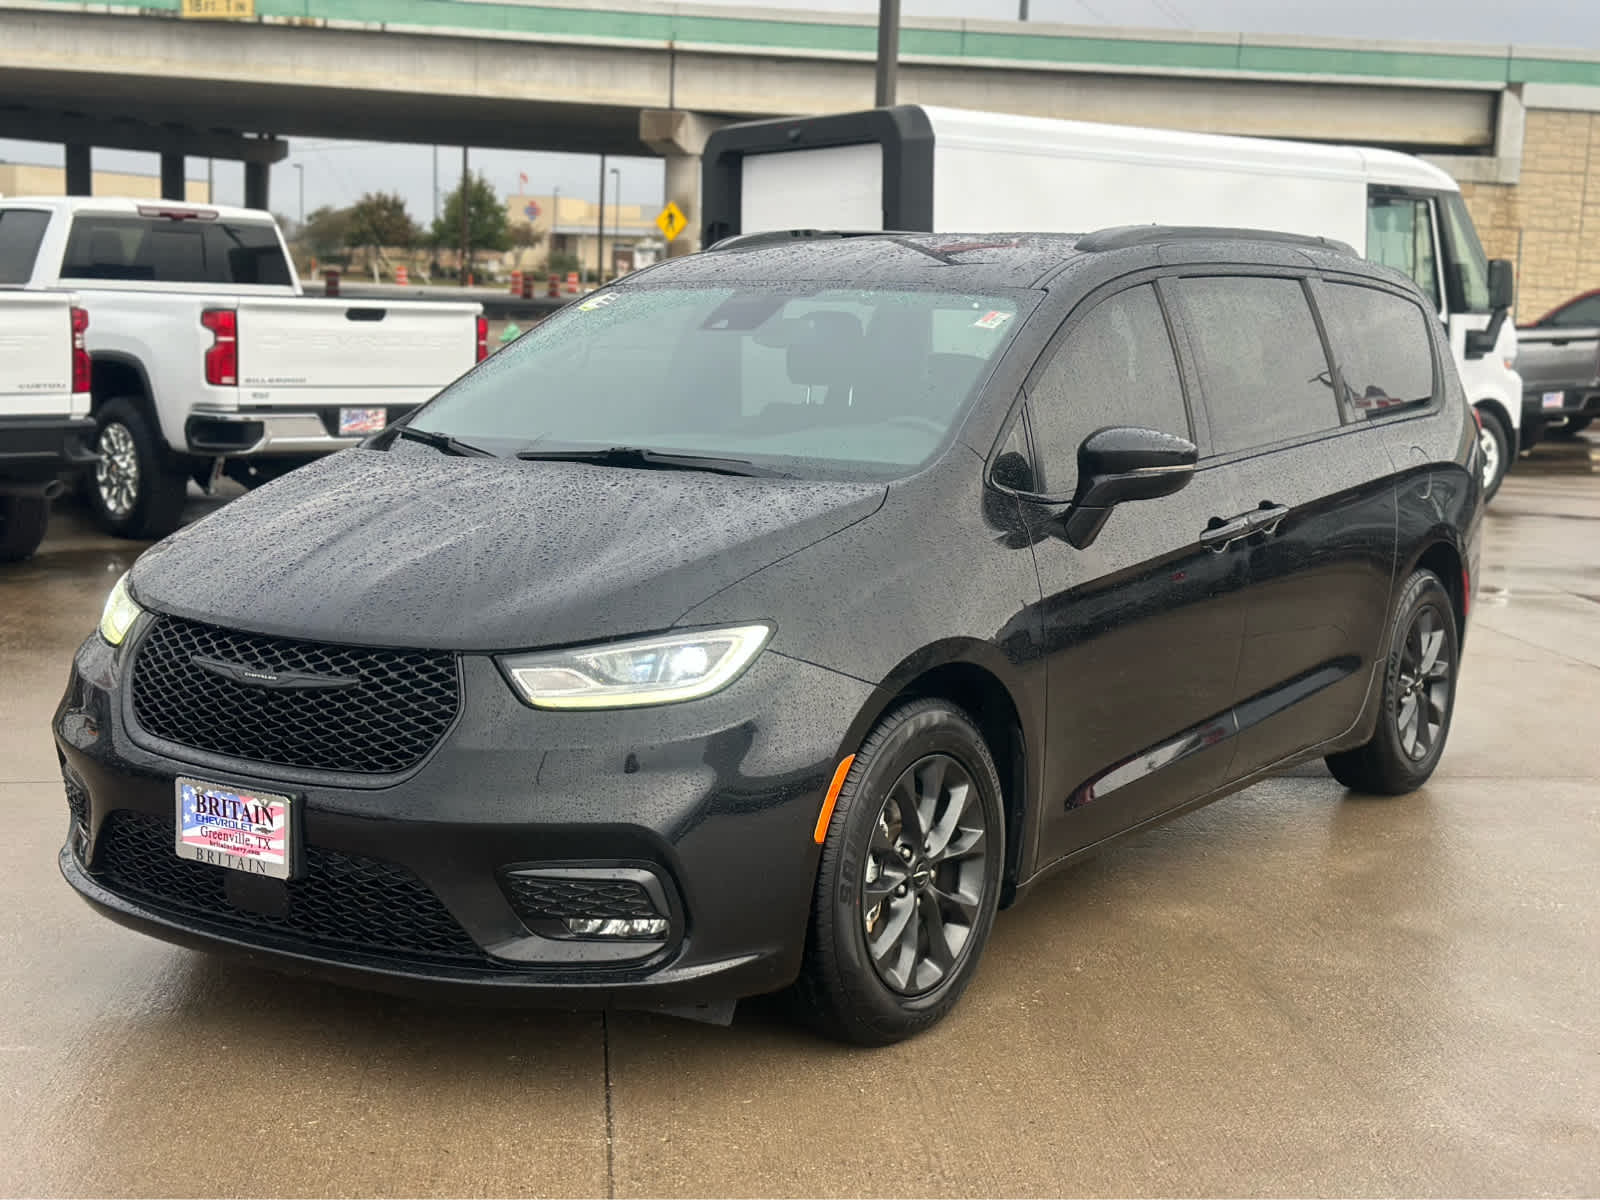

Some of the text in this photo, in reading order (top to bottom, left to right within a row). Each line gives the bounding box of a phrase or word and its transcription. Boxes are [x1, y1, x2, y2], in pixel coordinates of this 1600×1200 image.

[195, 793, 274, 828] BRITAIN
[195, 814, 253, 832] CHEVROLET
[200, 825, 272, 851] Greenville, TX
[196, 847, 266, 873] BRITAIN
